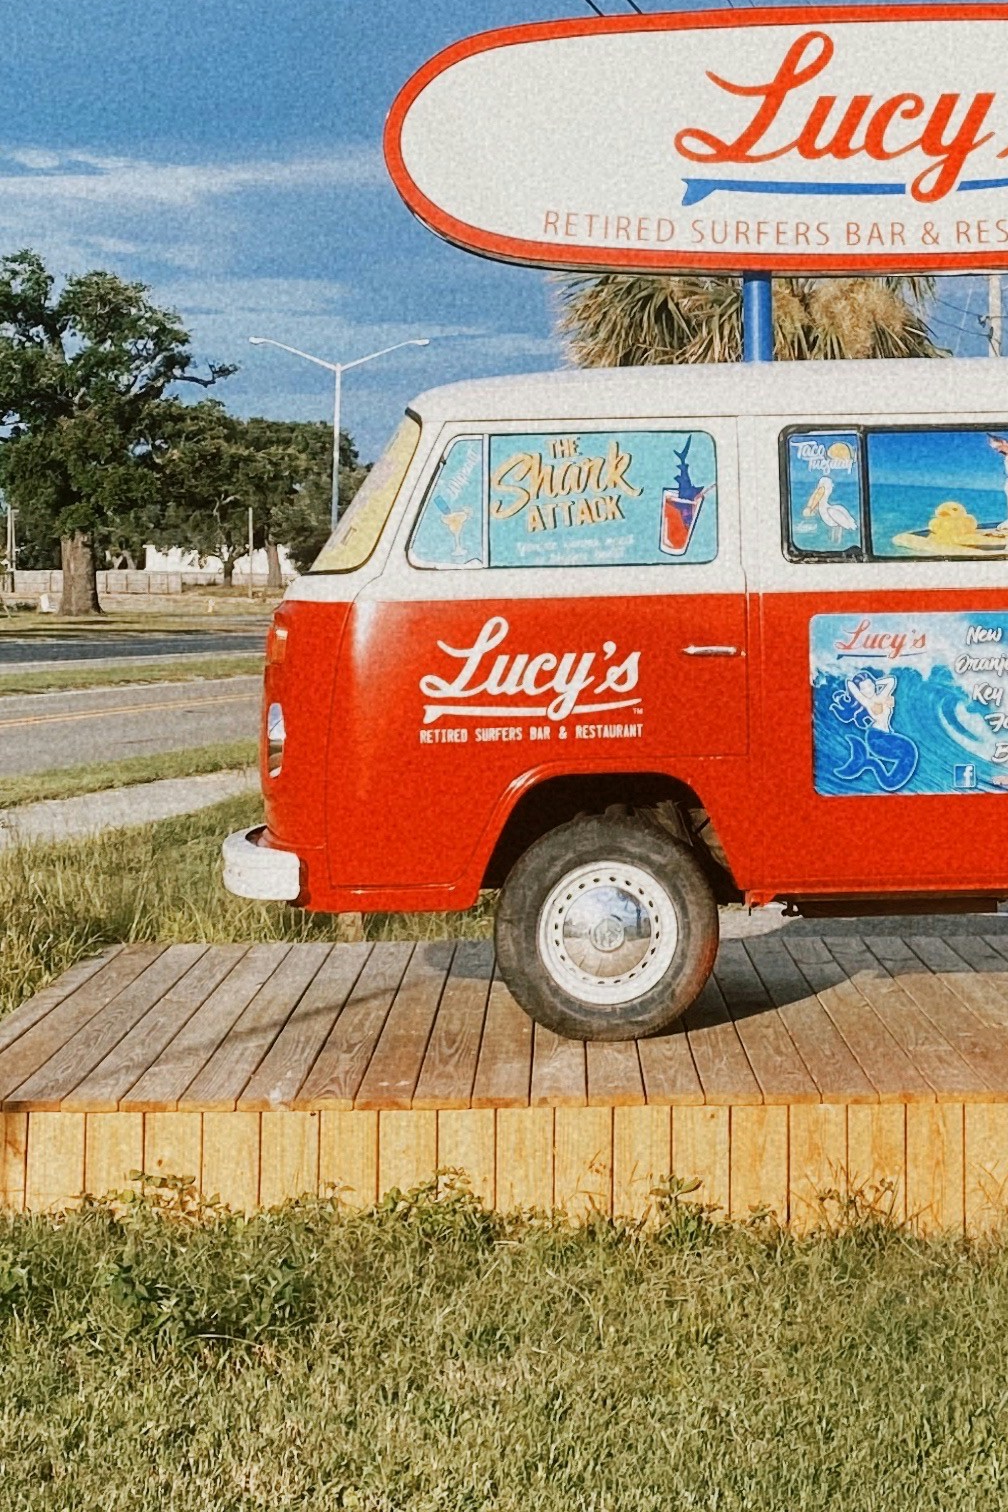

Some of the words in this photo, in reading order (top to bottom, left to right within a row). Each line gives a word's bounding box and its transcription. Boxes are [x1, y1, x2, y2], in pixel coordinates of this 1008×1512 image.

[543, 210, 676, 243] RETIRED
[691, 218, 831, 246] SURFERS
[846, 221, 906, 246] BAR
[920, 221, 940, 245] &
[546, 437, 583, 460] THE
[789, 441, 826, 461] Taco
[490, 440, 645, 520] Shark
[527, 494, 627, 533] ATTACK
[835, 619, 926, 659] Lucy's
[966, 625, 1002, 646] New
[419, 616, 642, 721] Lucy's
[972, 682, 1003, 706] Key
[420, 729, 468, 744] RETIRED
[475, 727, 523, 742] SURFERS
[530, 726, 551, 740] BAR
[558, 726, 567, 740] &
[575, 724, 644, 738] RESTAURANT
